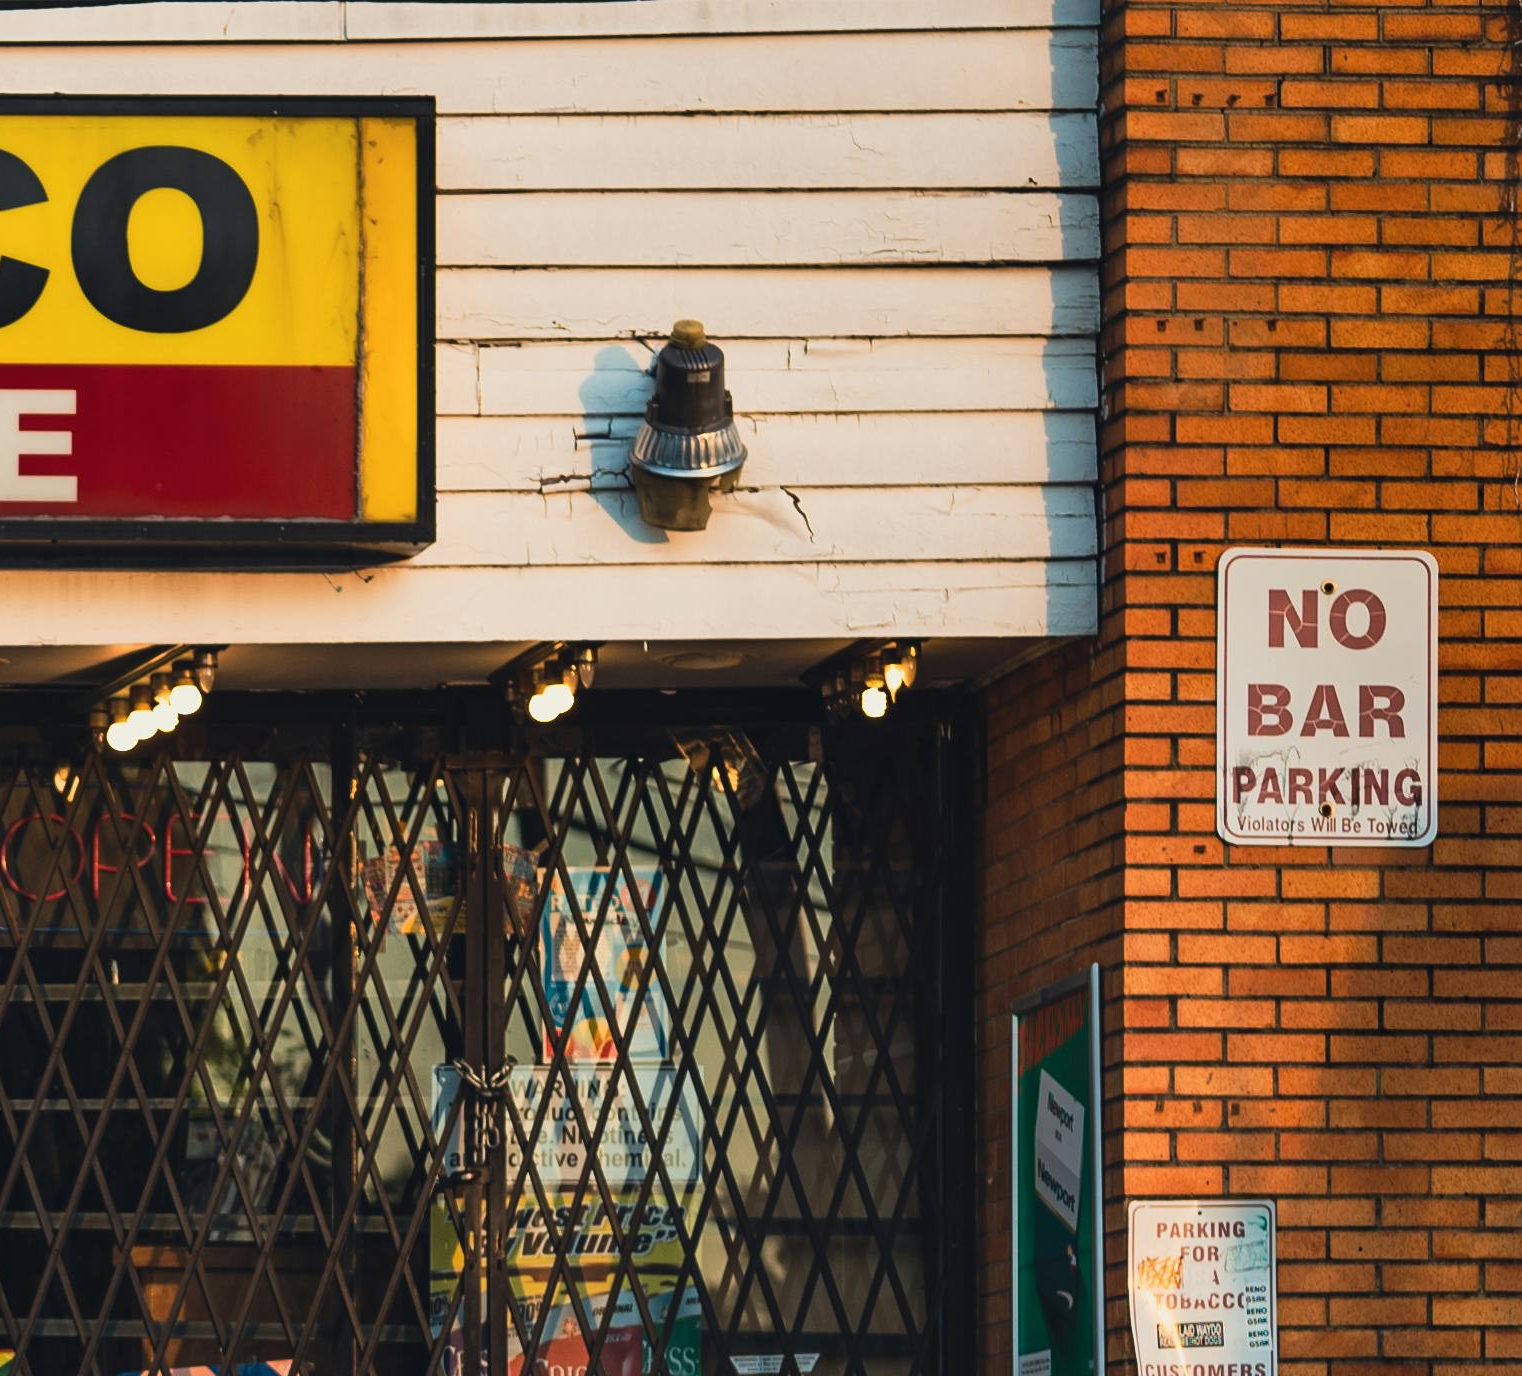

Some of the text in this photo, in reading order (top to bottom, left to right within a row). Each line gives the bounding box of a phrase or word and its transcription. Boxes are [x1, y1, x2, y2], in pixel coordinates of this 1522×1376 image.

[1268, 588, 1387, 650] NO
[1247, 683, 1406, 738] BAR
[1232, 766, 1423, 806] PARKING
[1237, 816, 1418, 835] Violators Will Be Towed
[592, 1101, 682, 1122] contins
[1047, 1091, 1075, 1132] Newport
[1036, 1159, 1076, 1213] Newport
[1156, 1221, 1246, 1238] PARKING
[1181, 1246, 1219, 1262] FOR
